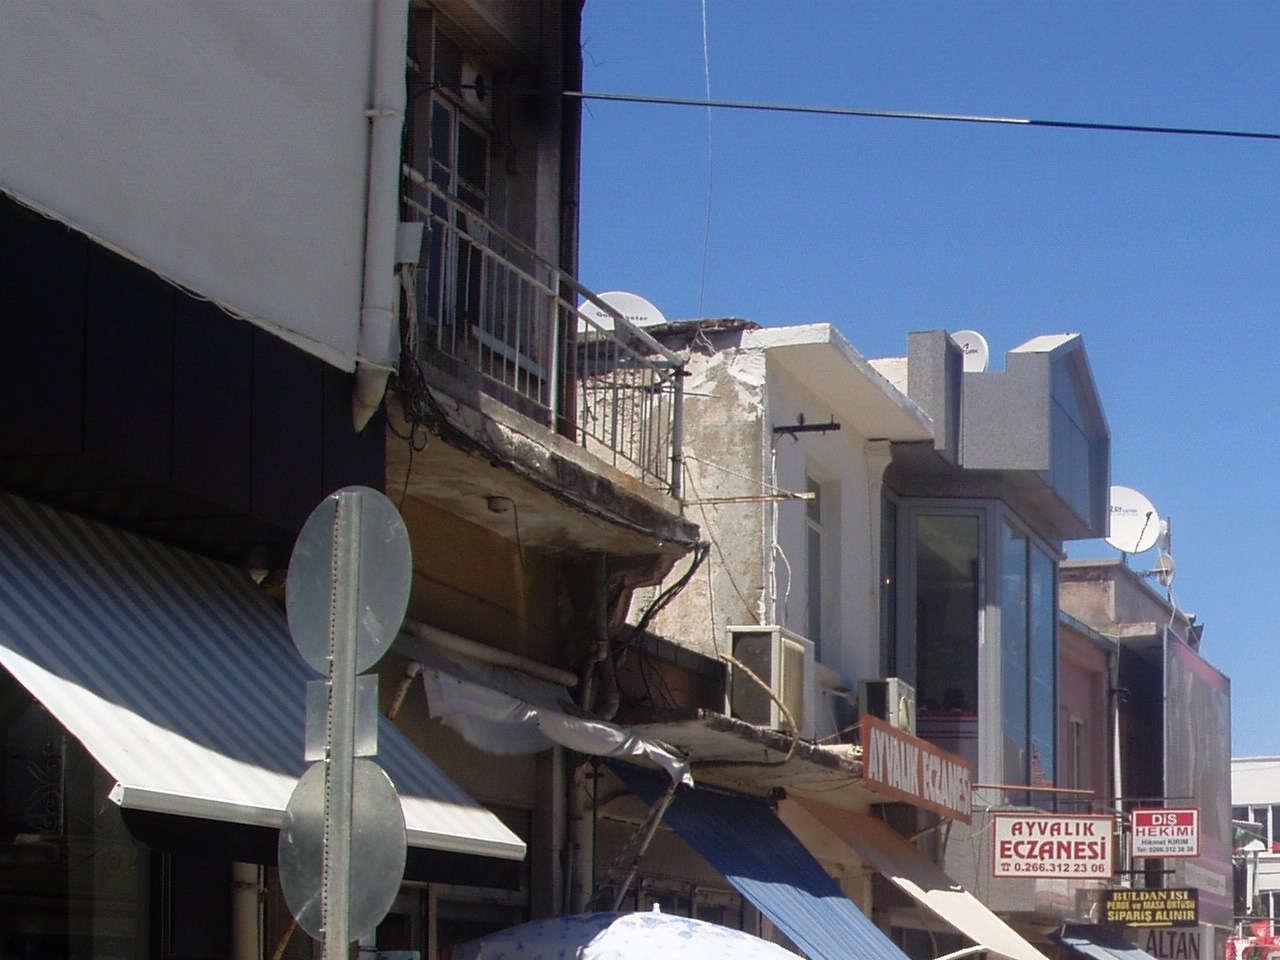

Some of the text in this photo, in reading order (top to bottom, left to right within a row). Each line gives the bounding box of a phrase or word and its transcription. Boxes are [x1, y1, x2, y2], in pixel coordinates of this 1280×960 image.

[868, 727, 920, 797] AYVALIK
[1011, 821, 1095, 837] AYVALIK
[1000, 836, 1106, 861] ECZANESİ
[1074, 863, 1088, 873] 23
[1113, 891, 1167, 901] BULDAN
[1143, 901, 1165, 909] MASA
[1107, 910, 1195, 922] SİPARİŞ ALINIR
[1145, 929, 1200, 960] ALTAN
